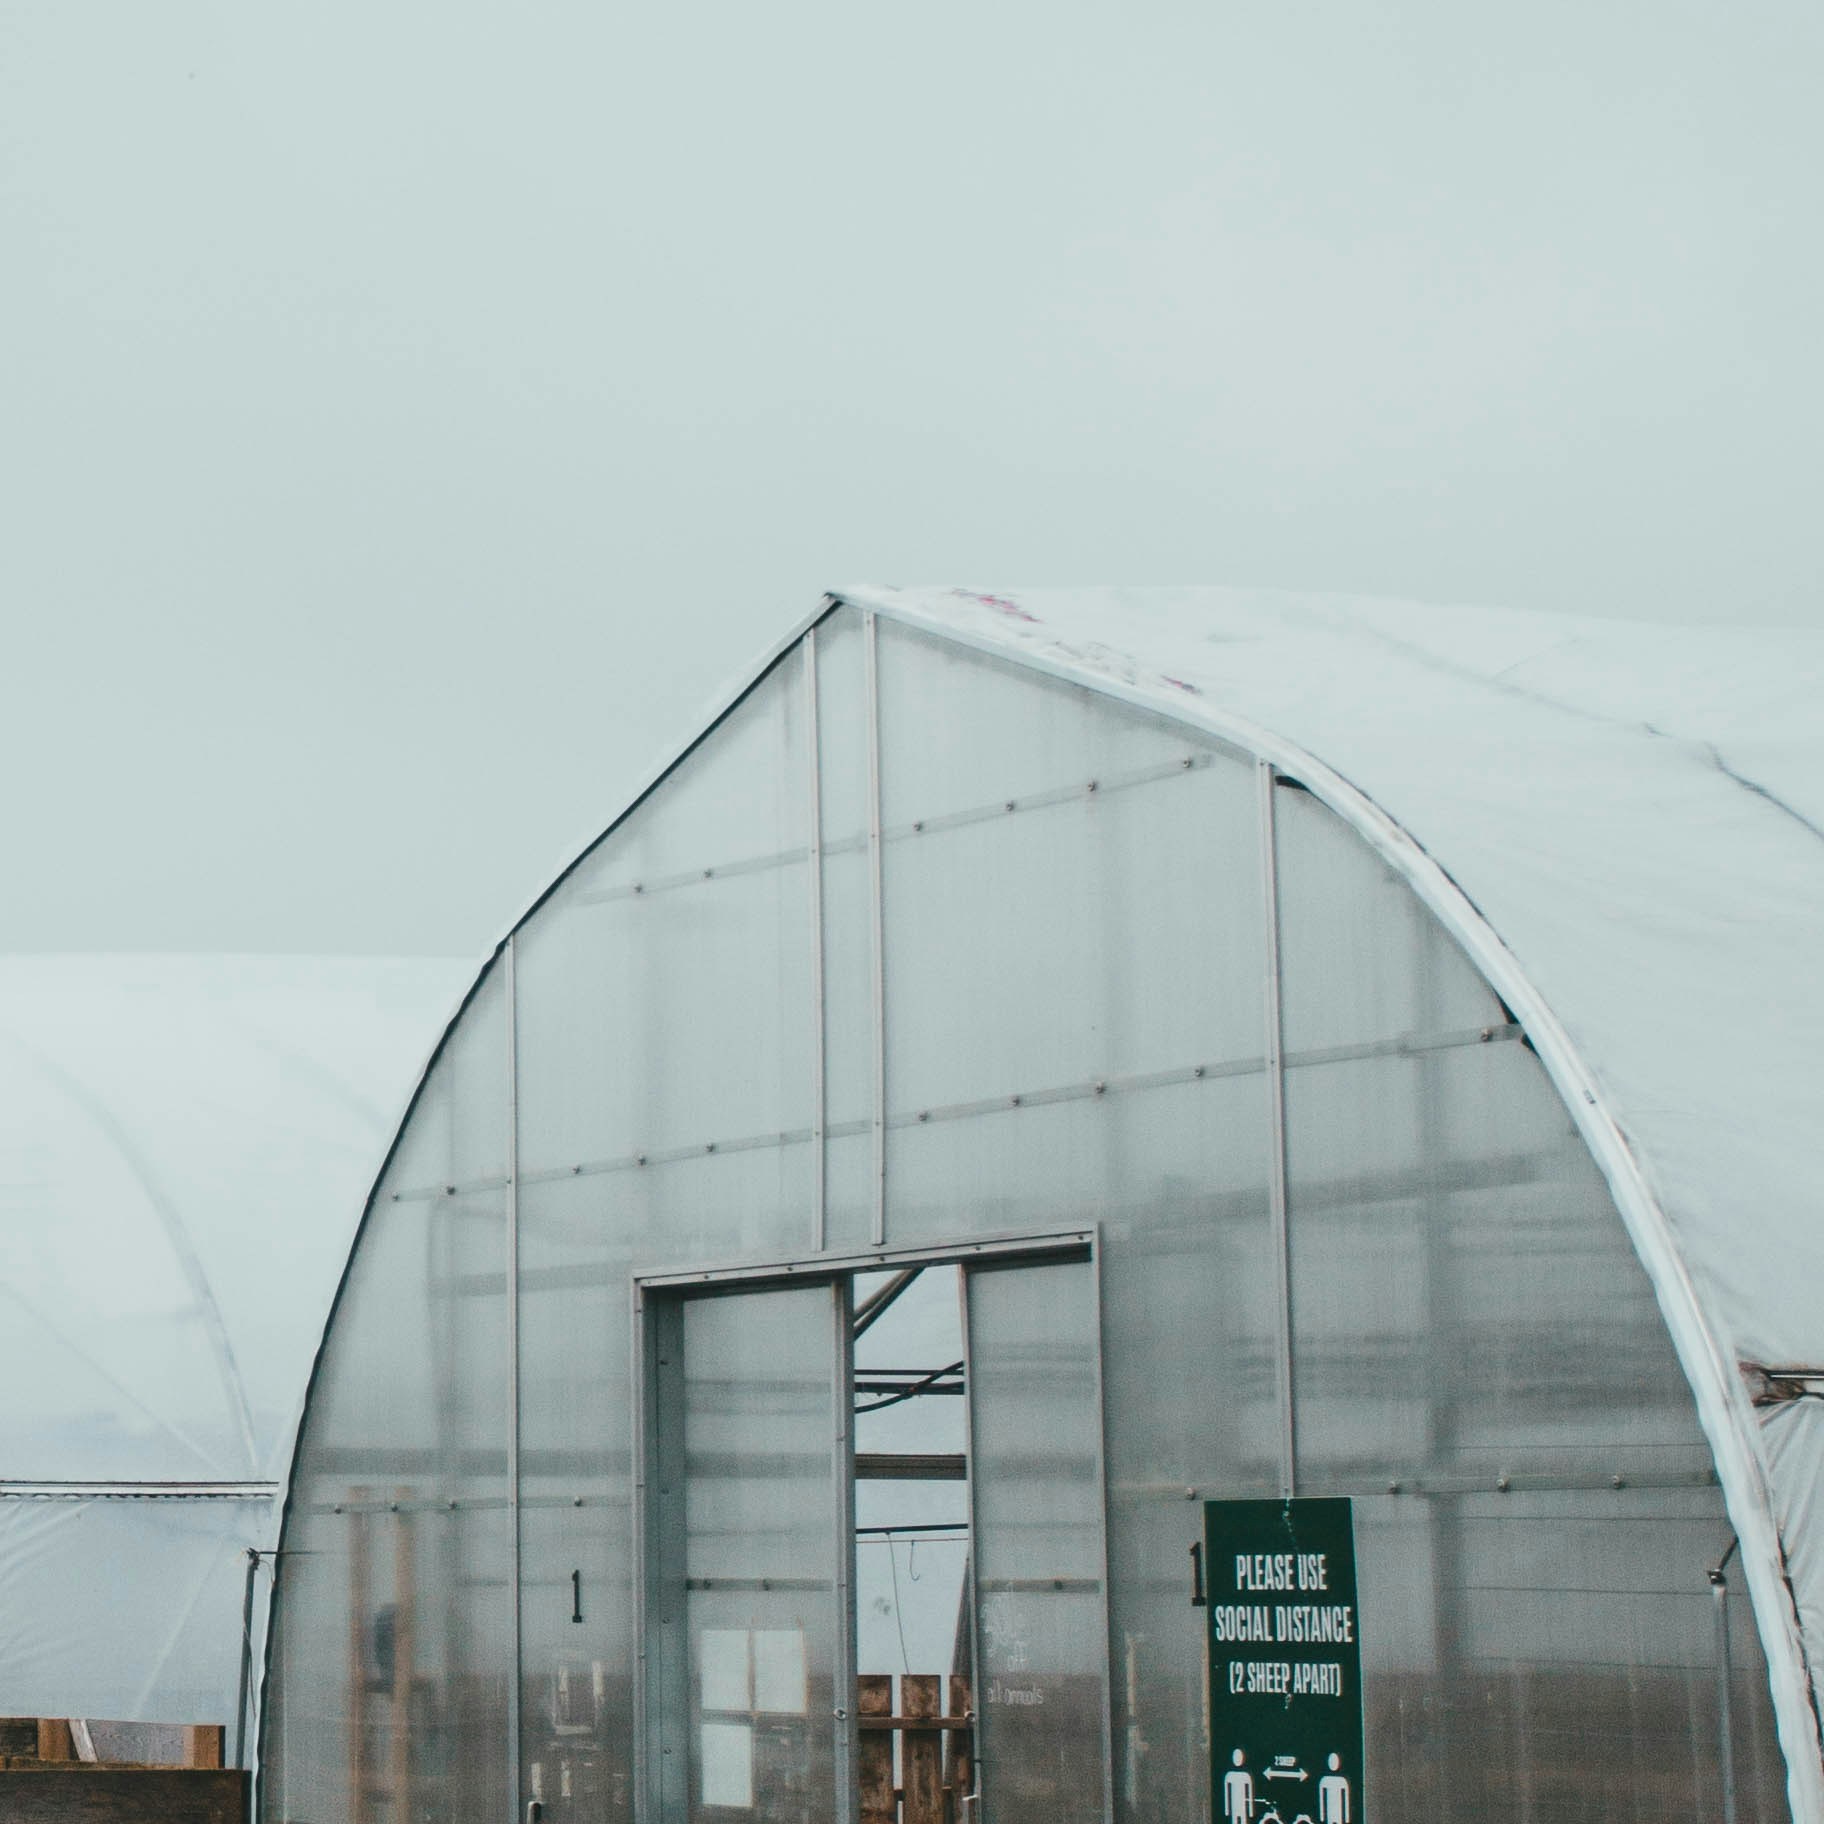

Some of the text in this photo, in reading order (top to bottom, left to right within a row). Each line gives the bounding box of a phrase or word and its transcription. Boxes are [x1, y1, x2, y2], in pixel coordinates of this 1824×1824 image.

[1189, 1542, 1206, 1607] 1
[1235, 1553, 1328, 1591] PLEASE USE
[572, 1569, 582, 1624] 1
[1215, 1605, 1353, 1644] SOCIAL DISTANCE
[1229, 1661, 1342, 1697] (2 SHEEP APART)
